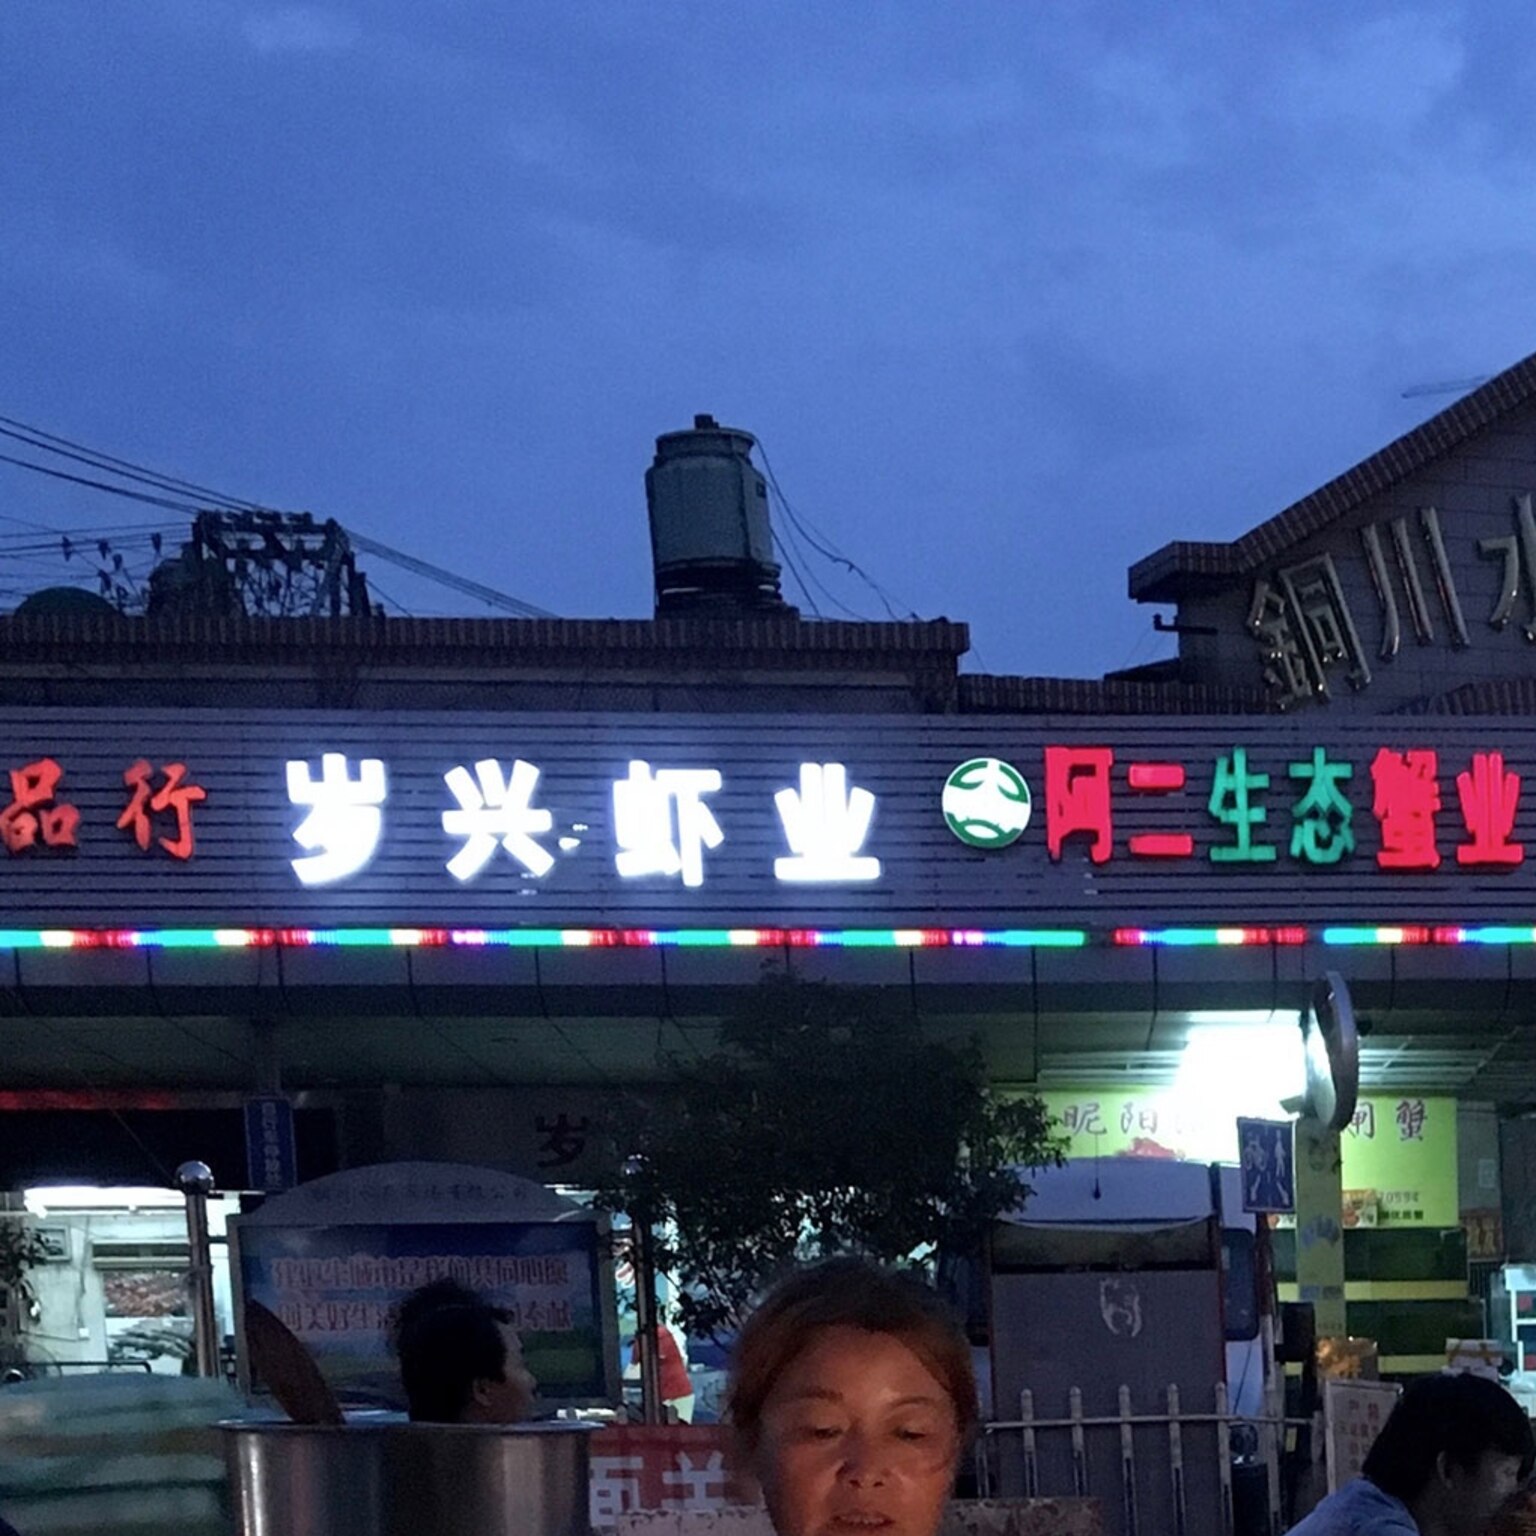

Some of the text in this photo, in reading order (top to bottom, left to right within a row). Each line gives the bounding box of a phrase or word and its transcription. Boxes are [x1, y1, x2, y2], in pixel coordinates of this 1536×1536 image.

[285, 752, 882, 887] 岁兴虾业
[1044, 745, 1525, 869] 阿二生态蟹业
